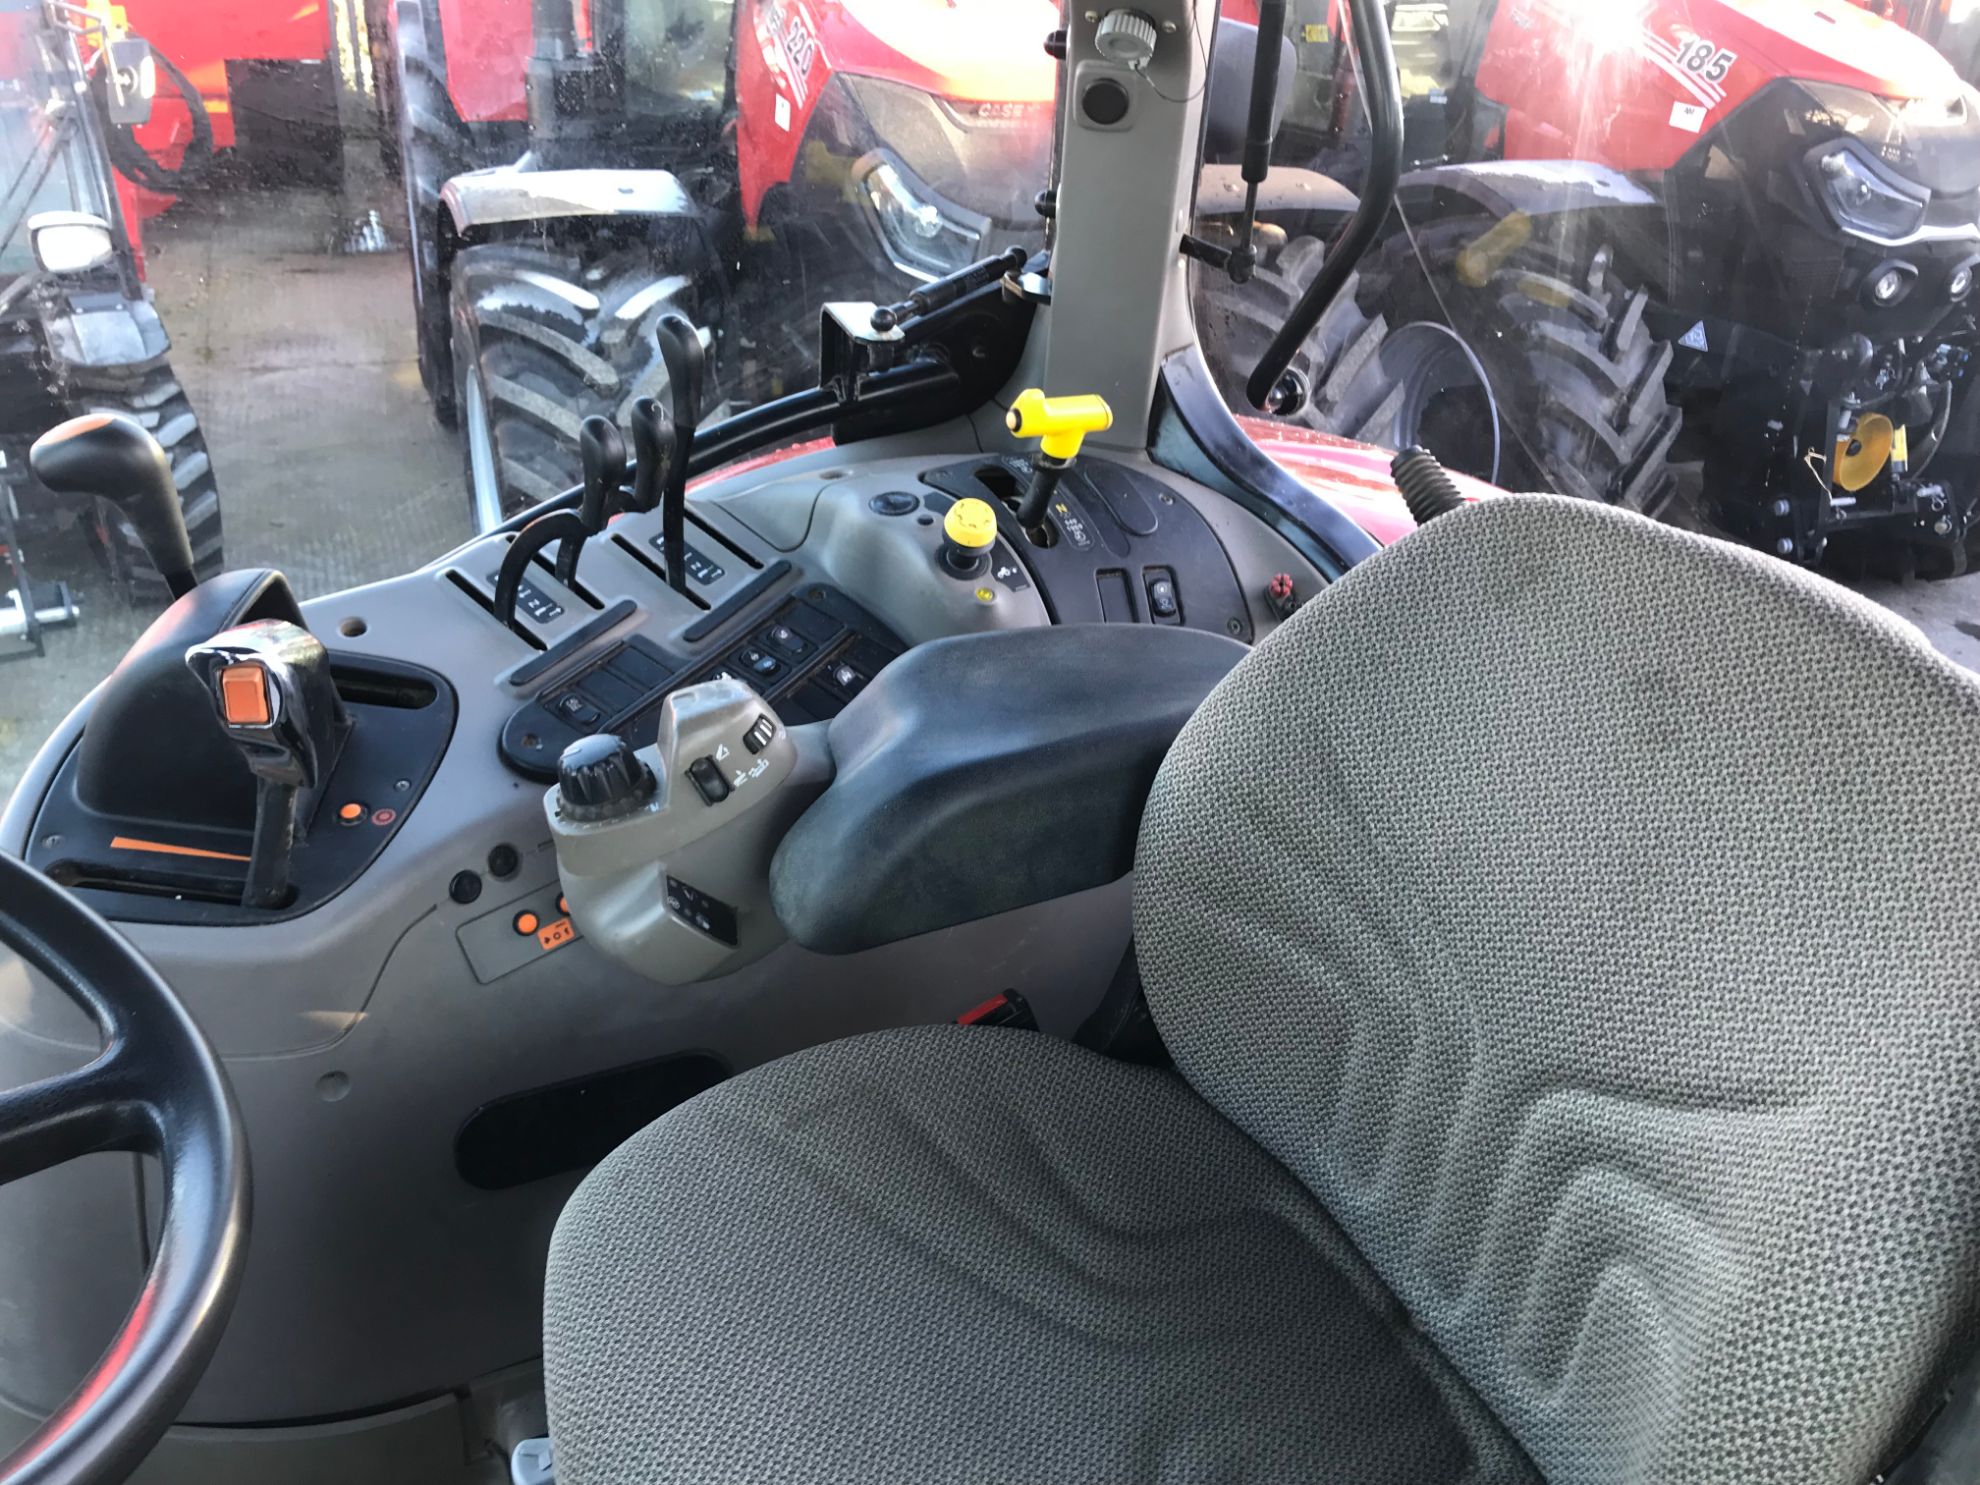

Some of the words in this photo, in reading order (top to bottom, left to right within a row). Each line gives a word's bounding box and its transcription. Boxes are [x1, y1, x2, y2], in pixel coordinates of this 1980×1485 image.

[786, 18, 814, 78] 220
[1676, 40, 1735, 82] 185
[978, 102, 1024, 118] CASE
